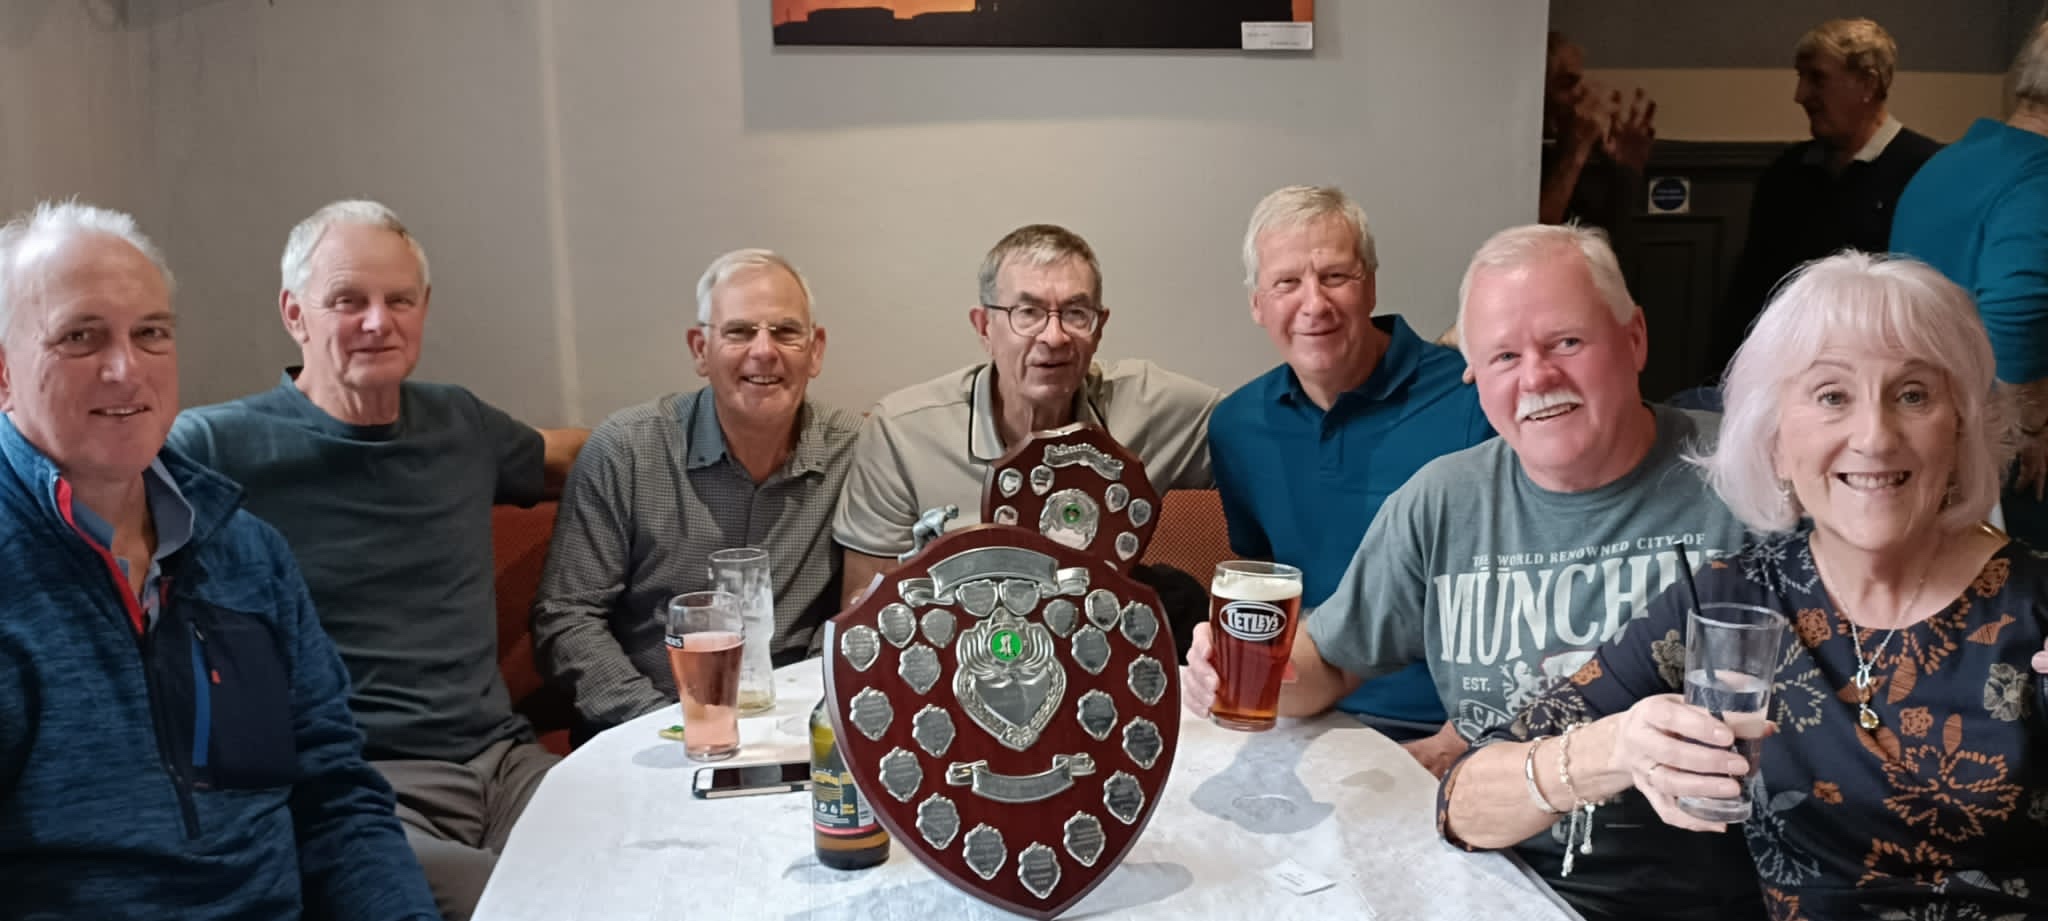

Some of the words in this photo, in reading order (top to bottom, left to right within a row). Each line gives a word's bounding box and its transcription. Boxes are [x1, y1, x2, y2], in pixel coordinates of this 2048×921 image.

[1497, 552, 1544, 566] WORLD
[1550, 540, 1630, 563] RENOWNED
[1636, 535, 1676, 549] CITY
[1682, 533, 1705, 545] OF
[1226, 608, 1279, 632] TETLEY'S
[1463, 676, 1491, 692] EST.
